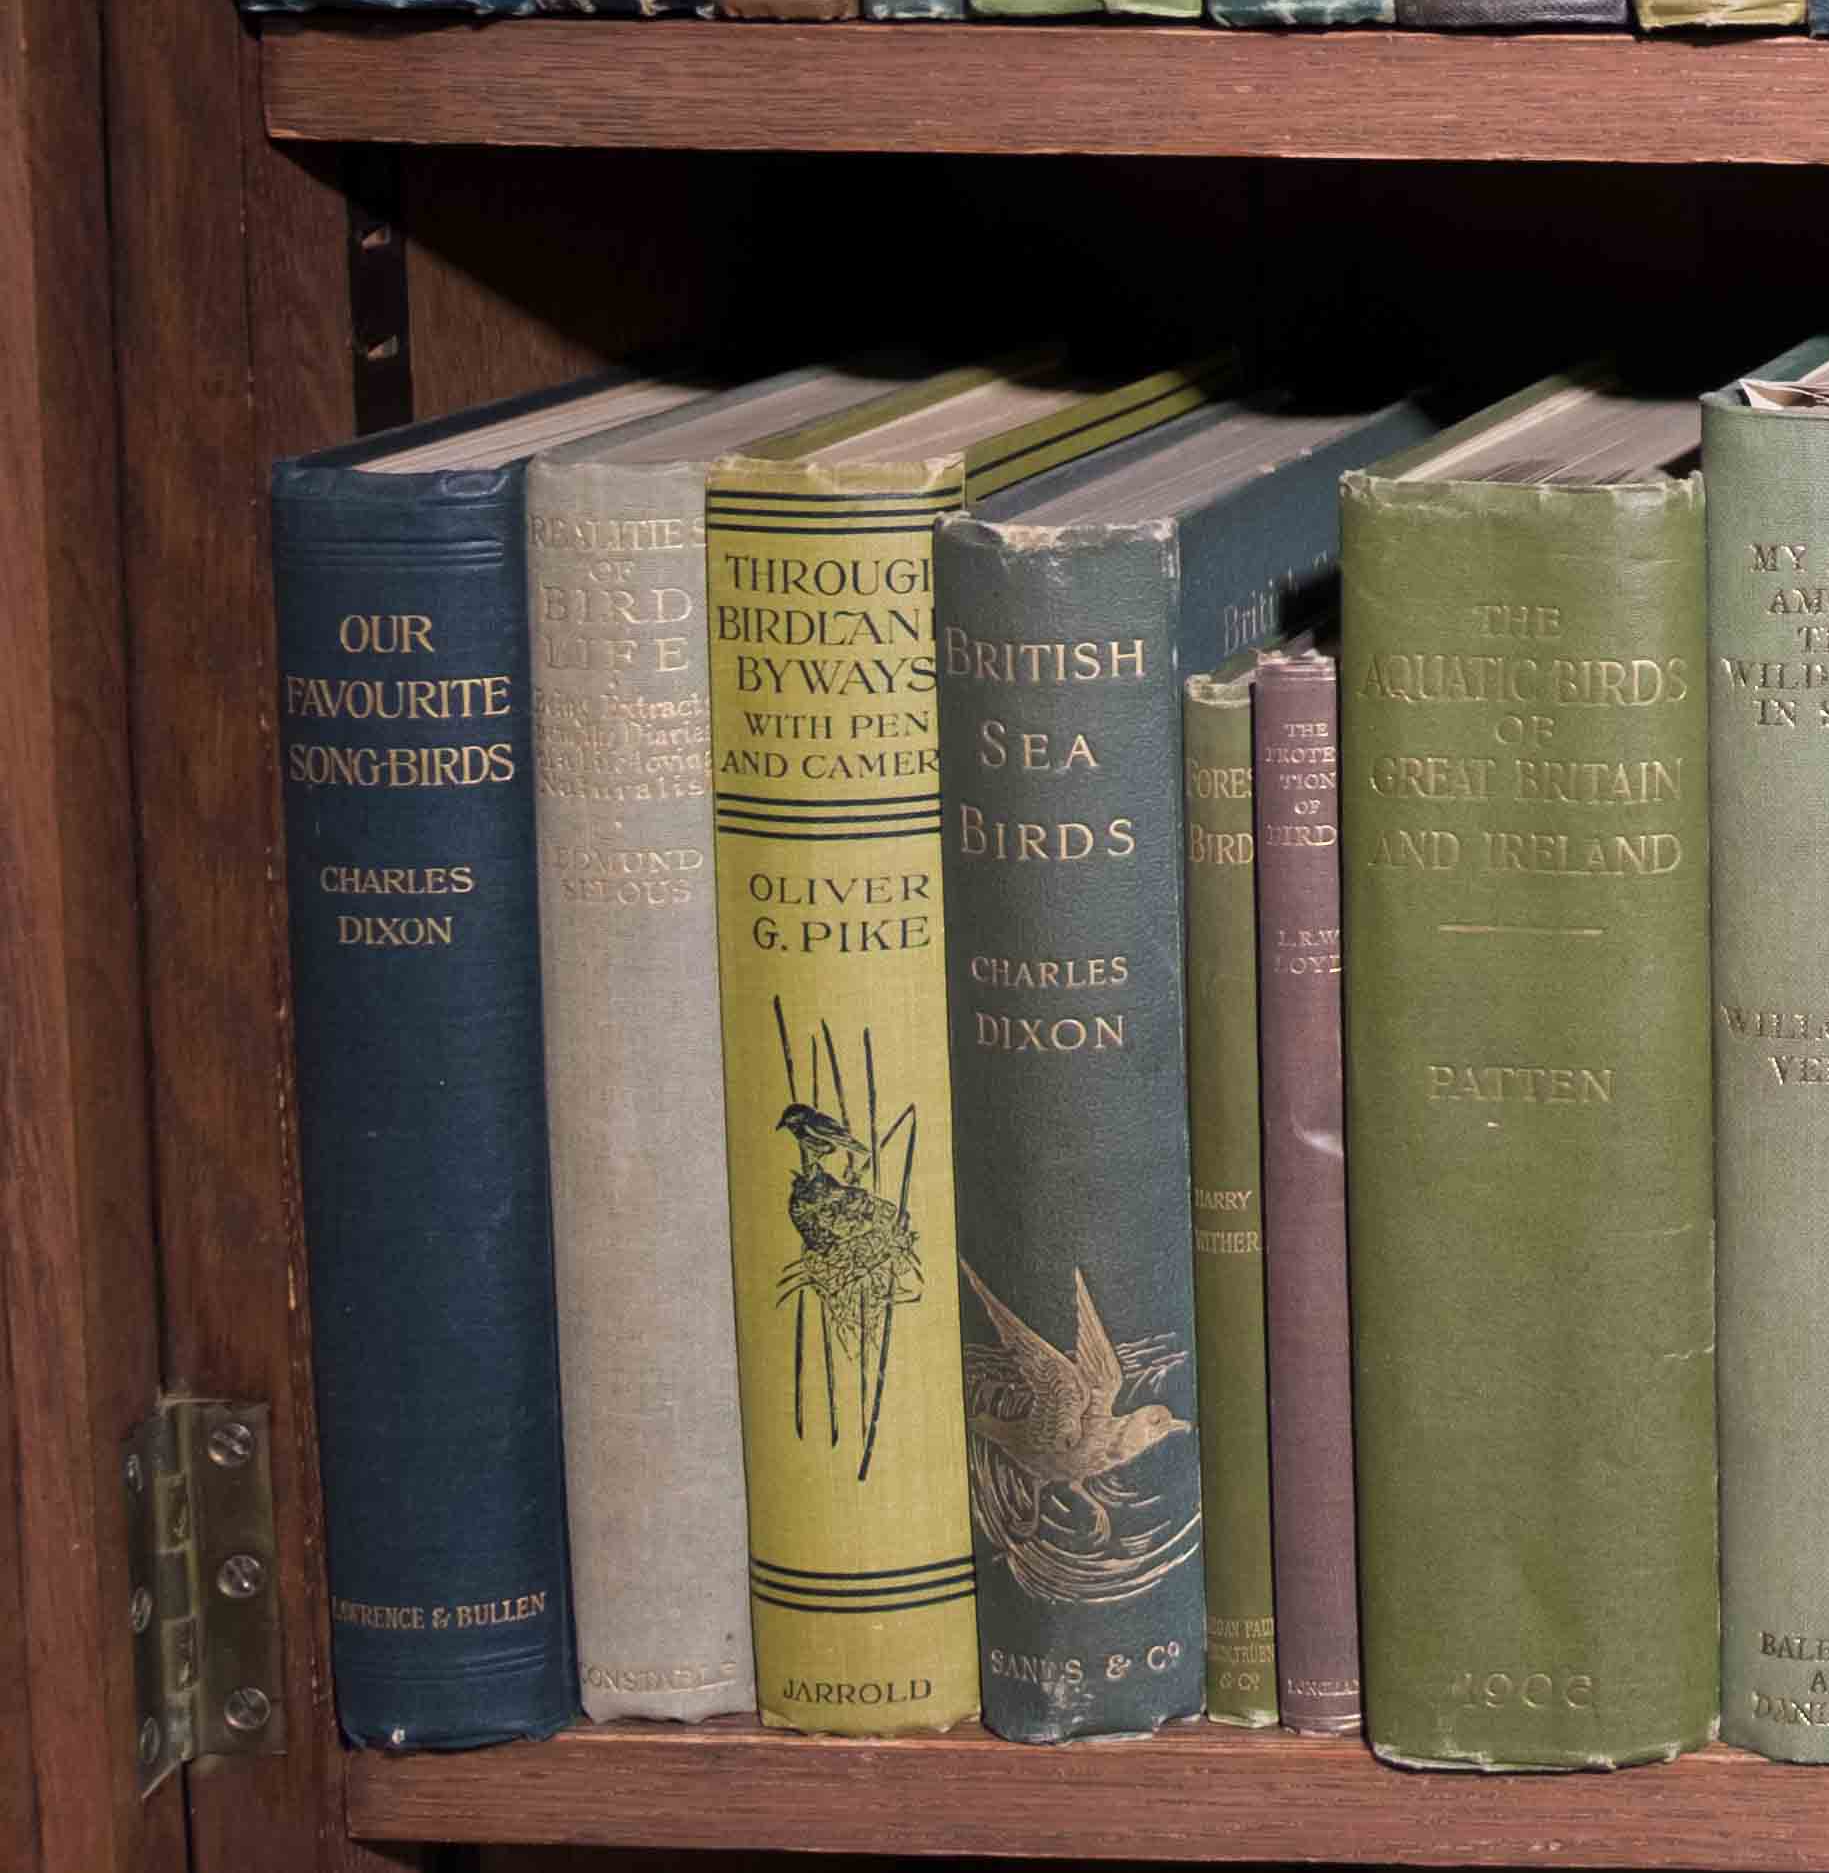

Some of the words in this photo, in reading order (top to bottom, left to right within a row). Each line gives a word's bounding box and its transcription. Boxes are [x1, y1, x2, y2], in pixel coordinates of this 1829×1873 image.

[340, 614, 433, 654] OUR
[943, 626, 1145, 683] BRITISH
[287, 675, 511, 720] FAVOURITE
[743, 710, 833, 741] WITH
[850, 710, 929, 741] PEN
[718, 749, 788, 777] AND
[981, 719, 1100, 772] SEA
[289, 743, 514, 788] SONG-BIRDS
[1371, 758, 1501, 801] GREAT
[1512, 757, 1683, 805] BRITAIN
[959, 804, 1136, 861] BIRDS
[320, 866, 474, 896] CHARLES
[748, 872, 931, 906] OLIVER
[336, 916, 453, 946] DIXON
[802, 916, 930, 953] PIKE
[971, 955, 1129, 990] CHARLES
[975, 1014, 1125, 1052] DIXON
[1427, 1064, 1617, 1104] PATTEN
[782, 1677, 933, 1706] JARROLD
